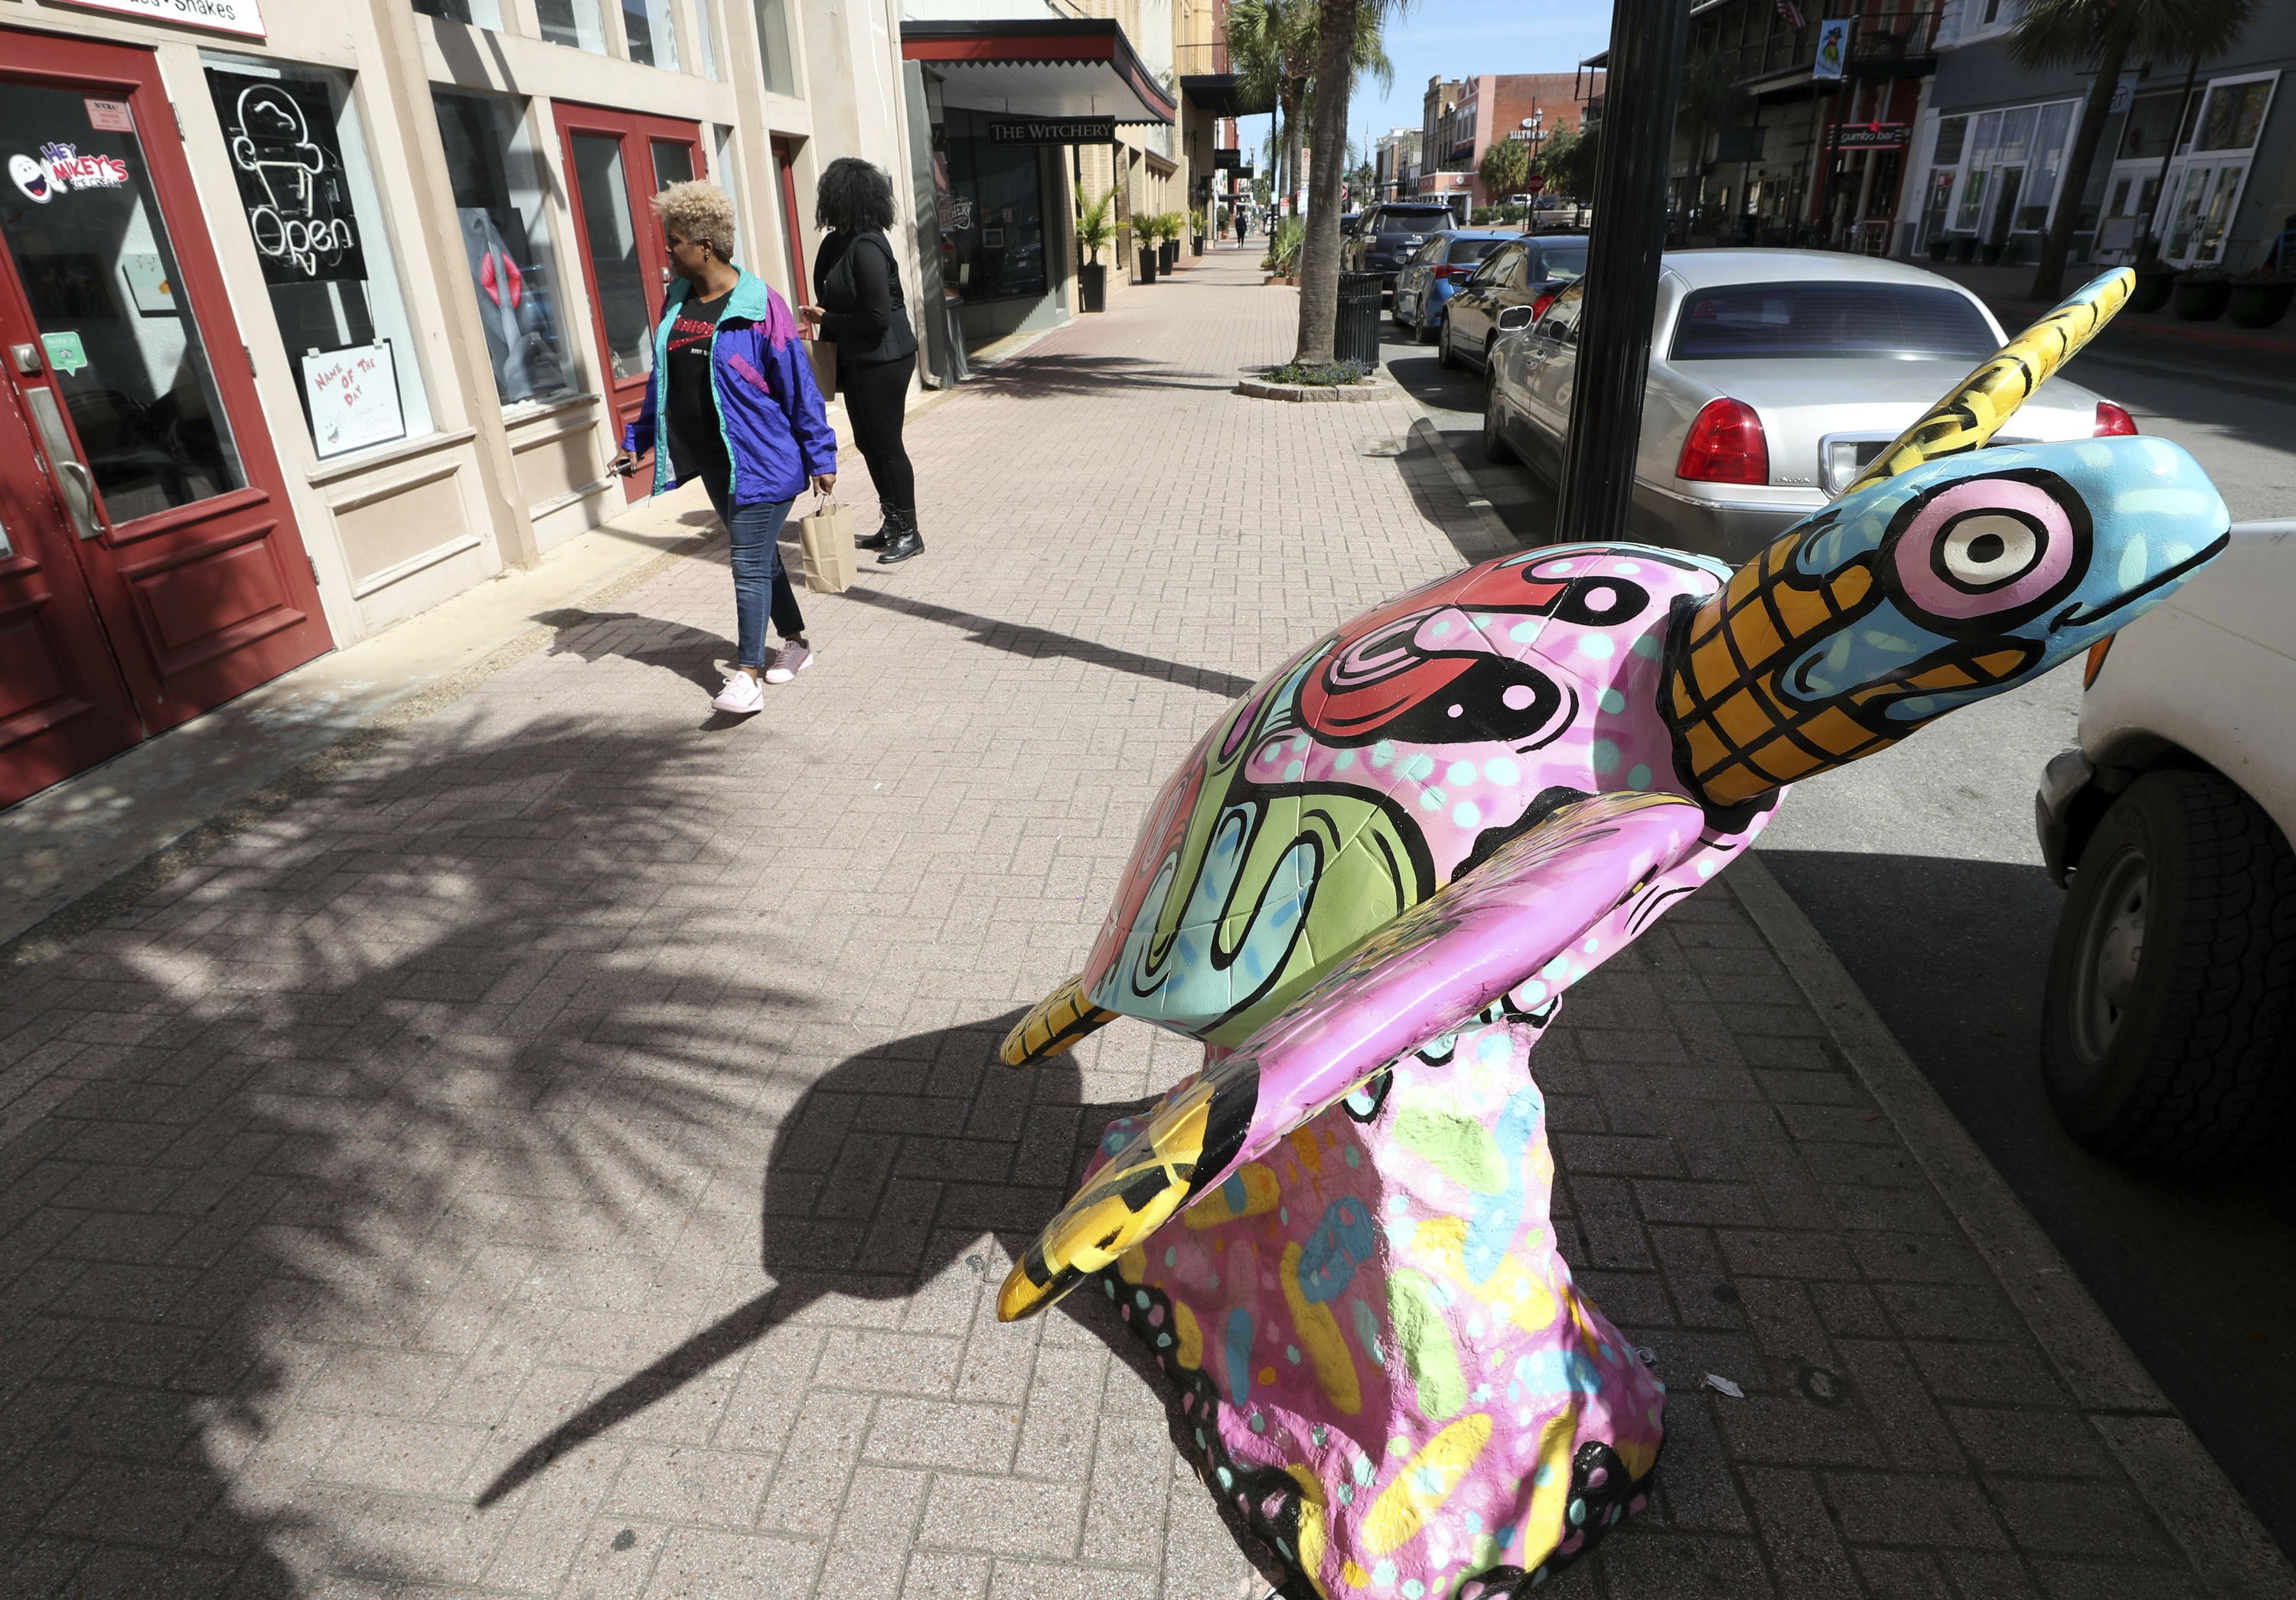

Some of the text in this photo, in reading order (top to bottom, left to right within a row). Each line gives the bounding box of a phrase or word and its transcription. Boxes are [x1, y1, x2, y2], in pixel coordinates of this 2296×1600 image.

[175, 0, 236, 20] Shakes
[991, 123, 1110, 140] THE WITCHERY
[1839, 130, 1894, 143] gumbo bar
[41, 142, 76, 163] HEY
[53, 155, 129, 181] MIKEY'S
[70, 178, 122, 190] ICE CREAM
[252, 207, 353, 265] Open
[315, 358, 375, 391] NAME OF THE
[344, 384, 362, 407] DAY
